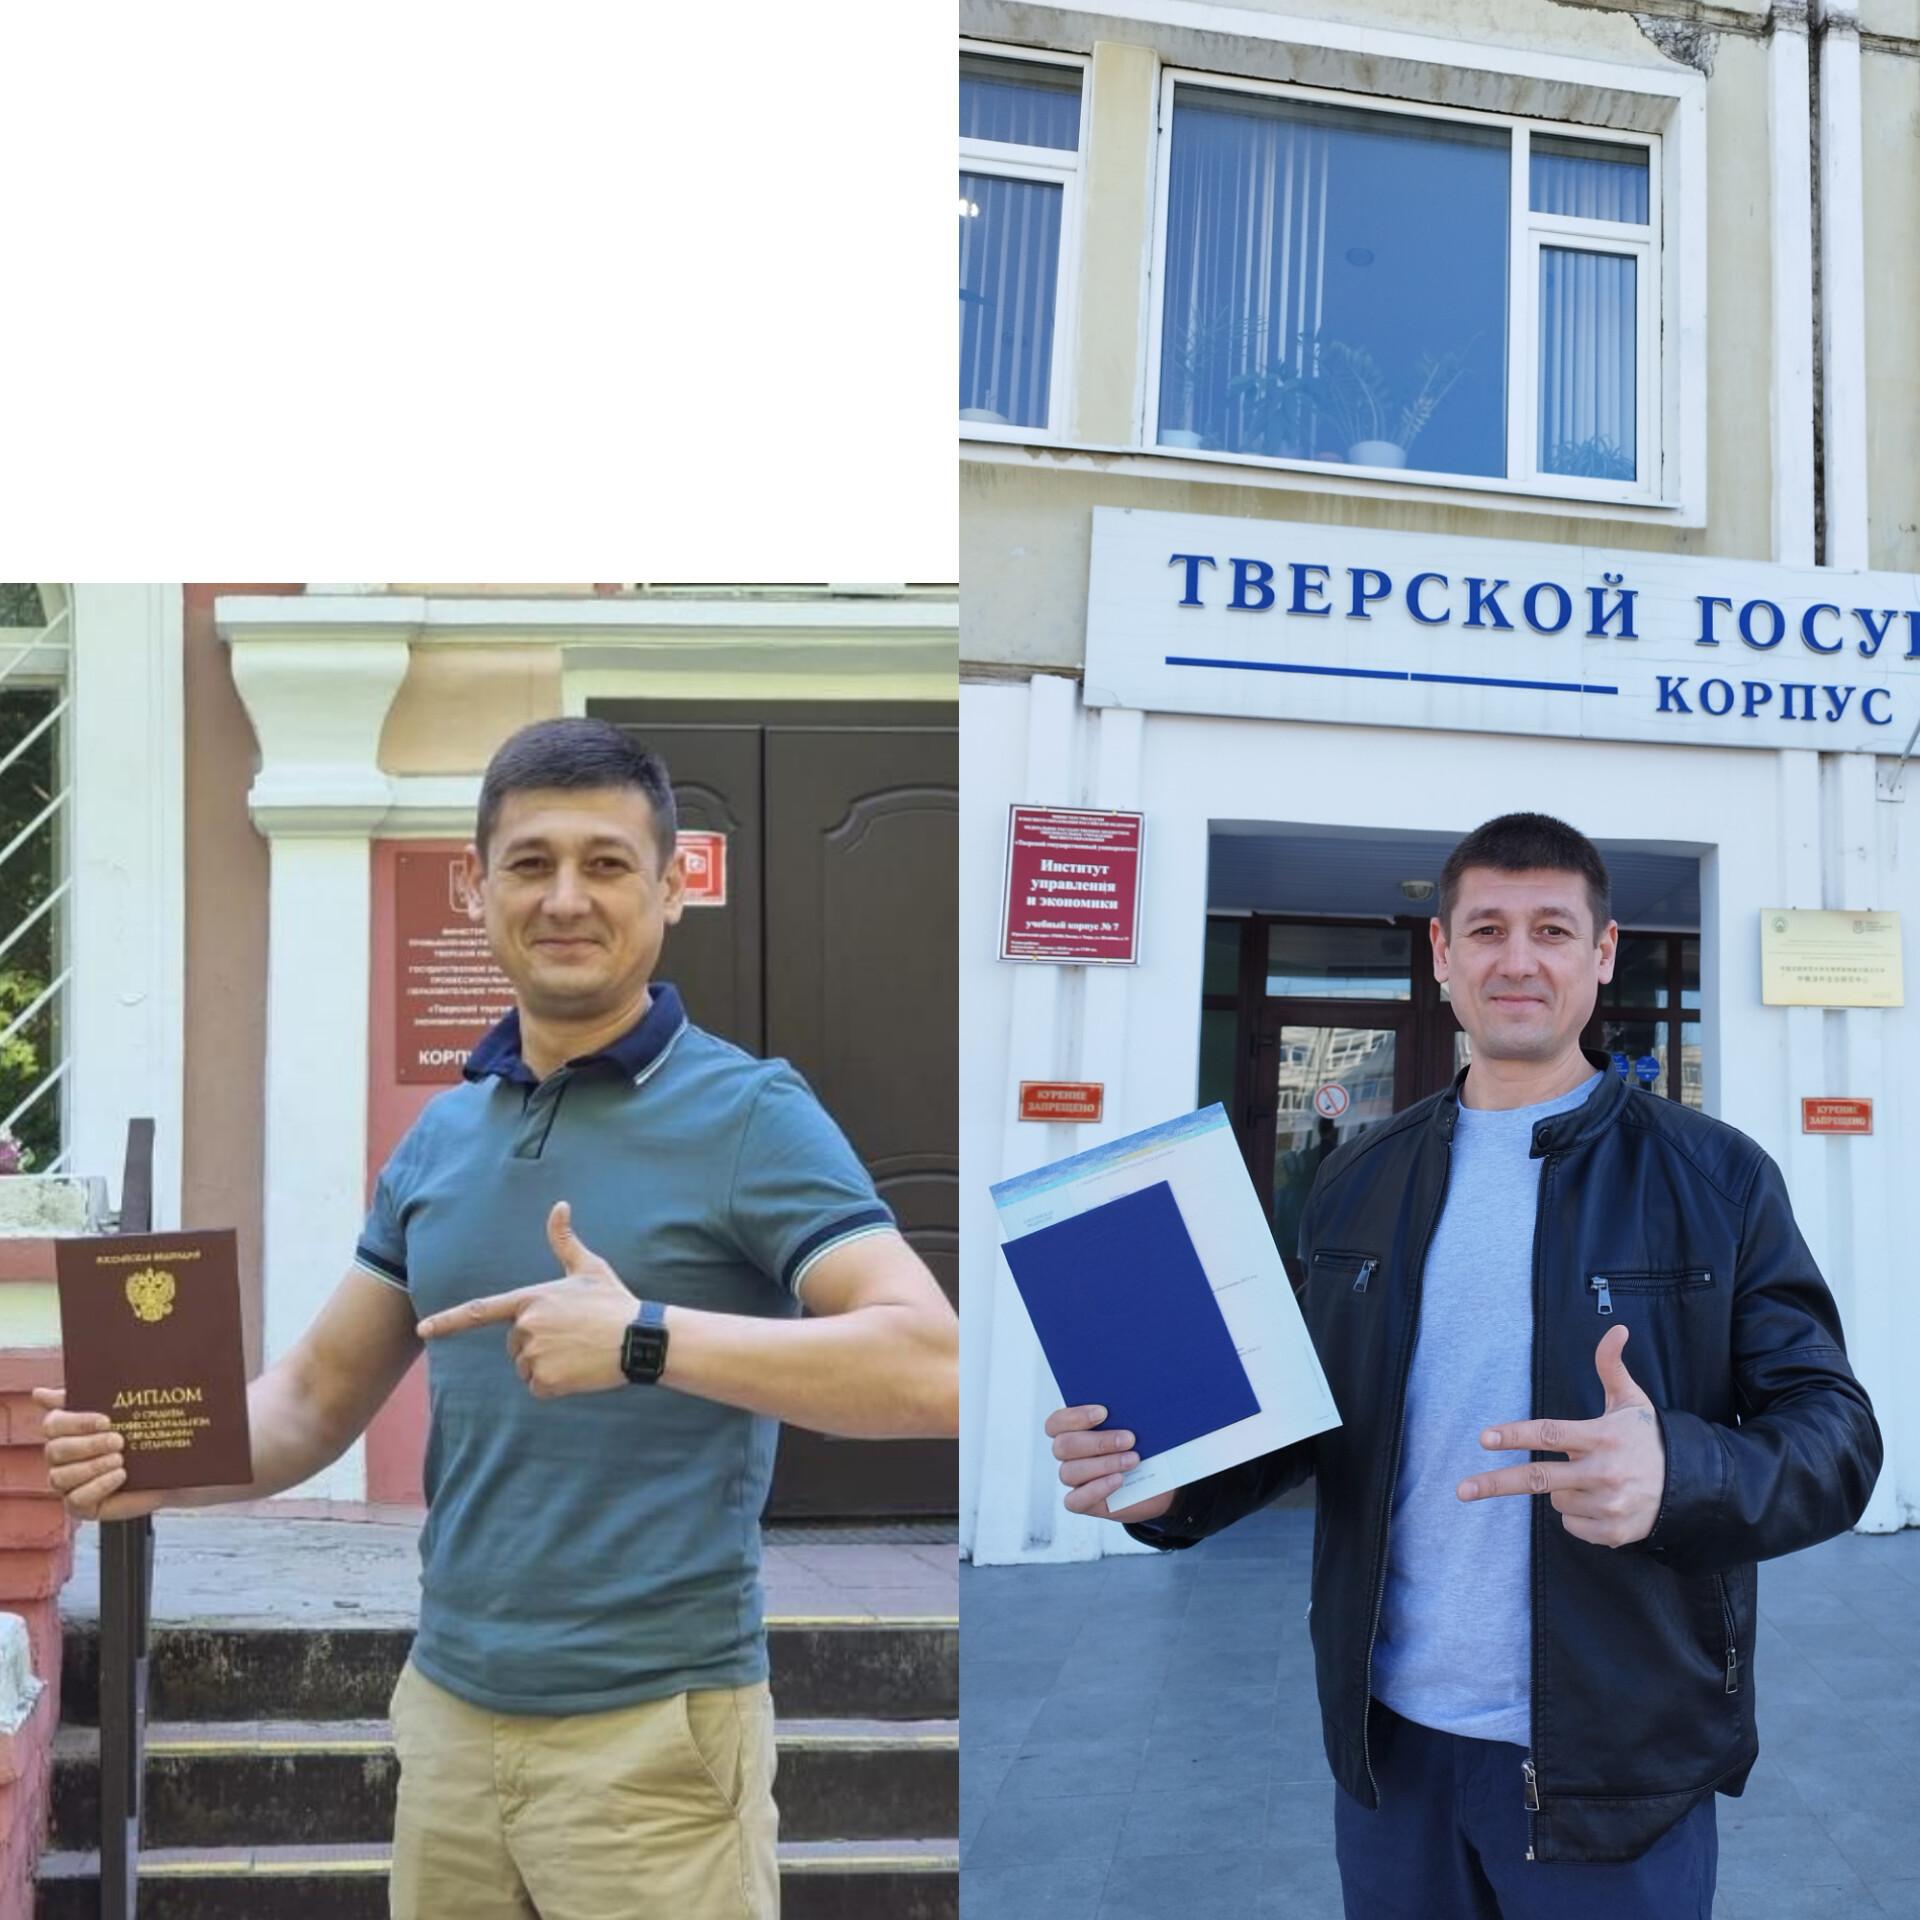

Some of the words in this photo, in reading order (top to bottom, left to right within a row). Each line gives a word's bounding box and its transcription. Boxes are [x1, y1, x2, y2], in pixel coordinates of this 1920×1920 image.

[1169, 553, 1639, 640] ТВЕРСКОЙ
[1656, 675, 1893, 725] КОРПУС
[1040, 859, 1110, 876] Институт
[1030, 878, 1116, 892] управления
[1026, 896, 1036, 906] и
[1039, 896, 1118, 909] экономики
[419, 1050, 472, 1065] КОРП
[1037, 1090, 1088, 1101] КУРЕНИЕ
[1028, 1102, 1095, 1112] ЗАПРЕЩЕНО
[112, 1387, 202, 1408] ДИПЛОМ
